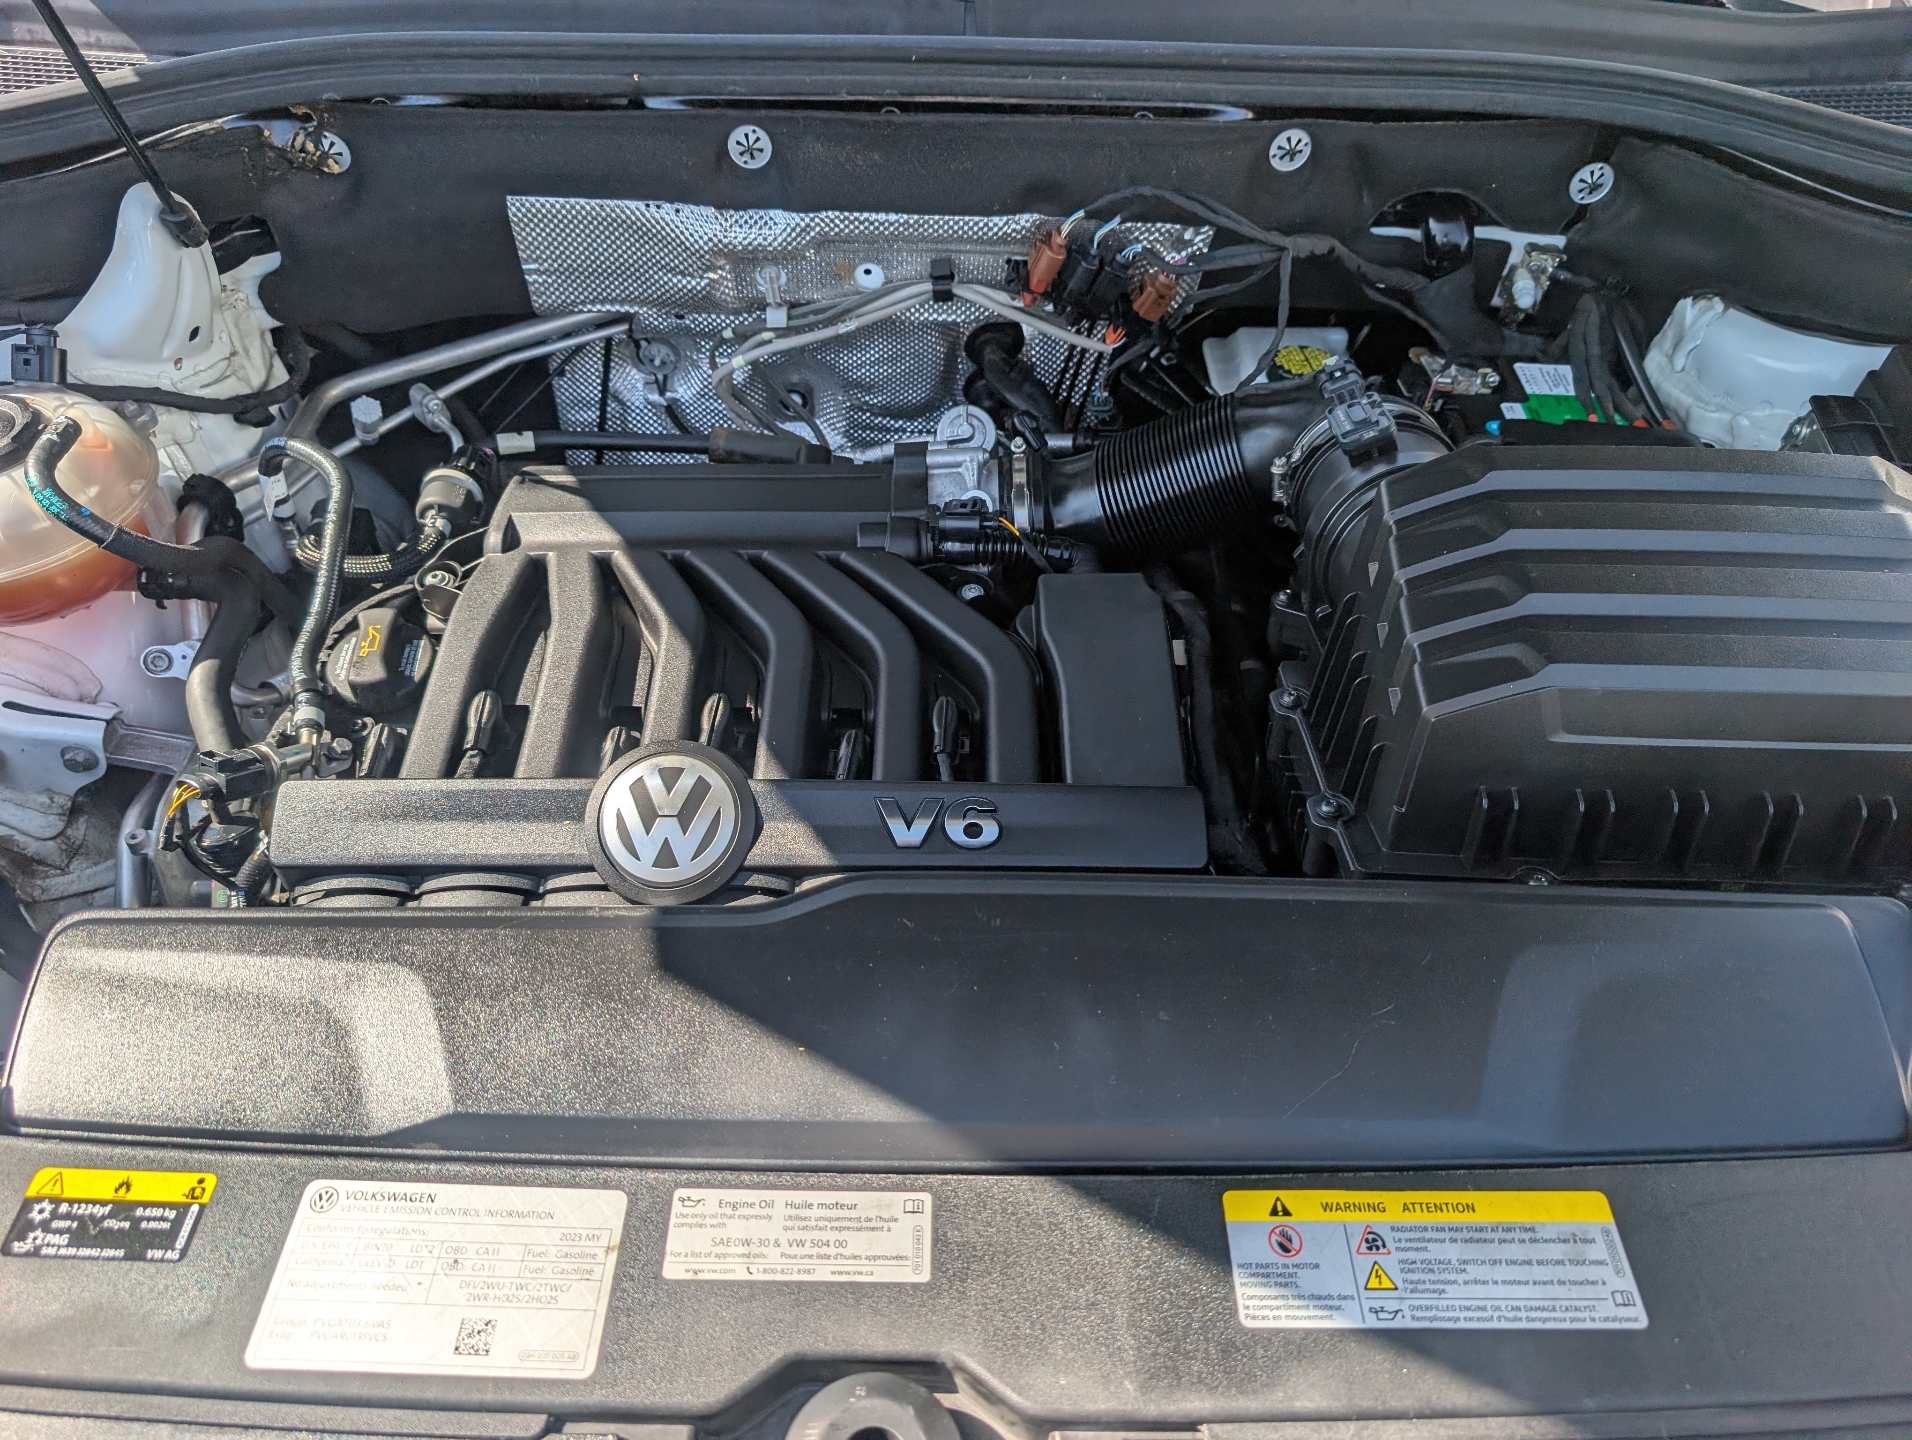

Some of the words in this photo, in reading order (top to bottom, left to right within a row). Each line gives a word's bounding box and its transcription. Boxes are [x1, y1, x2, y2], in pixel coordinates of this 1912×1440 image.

[874, 797, 1001, 850] V6
[346, 1189, 437, 1204] VOLKSWAGEN
[58, 1202, 113, 1217] R-1234yf
[718, 1198, 756, 1211] Engine
[758, 1199, 775, 1209] Oil
[785, 1200, 814, 1210] Huile
[817, 1202, 858, 1210] moteur
[1320, 1201, 1386, 1213] WARNING
[1402, 1202, 1476, 1214] ATTENTION
[135, 1206, 163, 1217] 0.650
[164, 1207, 177, 1219] kg
[341, 1204, 380, 1214] VEHICLE
[383, 1204, 432, 1215] EMISSION
[435, 1207, 481, 1217] CONTROL
[484, 1209, 555, 1220] INFORMATION
[675, 1211, 690, 1219] Use
[690, 1212, 707, 1221] only
[720, 1212, 736, 1220] that
[738, 1213, 773, 1222] expressly
[783, 1214, 812, 1222] Utilisez
[814, 1215, 862, 1223] uniquement
[307, 1222, 355, 1234] Conforms
[358, 1225, 368, 1234] to
[370, 1225, 430, 1237] regulations:
[673, 1221, 708, 1230] complies
[709, 1221, 727, 1229] with
[782, 1223, 796, 1232] qui
[829, 1224, 884, 1233] expressément
[44, 1233, 70, 1246] PAG
[559, 1232, 582, 1242] 2023
[585, 1233, 602, 1242] MY
[1498, 1236, 1515, 1245] peut
[772, 1238, 781, 1248] &
[787, 1239, 806, 1248] VW
[809, 1239, 831, 1248] 504
[833, 1239, 848, 1248] 00
[445, 1246, 470, 1255] OBD:
[526, 1248, 550, 1258] Fuel:
[555, 1250, 598, 1260] Gasoline
[1395, 1245, 1431, 1253] moment.
[146, 1248, 164, 1260] VW
[164, 1249, 180, 1261] AG
[669, 1250, 682, 1258] For
[714, 1251, 751, 1260] approved
[815, 1252, 832, 1260] liste
[522, 1264, 547, 1274] Fuel:
[551, 1266, 595, 1276] Gasoline
[1237, 1262, 1253, 1270] HOT
[1254, 1262, 1279, 1270] PARTS
[1238, 1271, 1301, 1279] COMPARTMENT.
[1240, 1281, 1272, 1289] MOVING
[1273, 1281, 1302, 1289] PARTS.
[1402, 1278, 1426, 1286] Haute
[1462, 1278, 1490, 1286] arrêter
[1492, 1278, 1499, 1286] le
[1501, 1278, 1530, 1286] moteur
[1531, 1278, 1555, 1286] avant
[1557, 1278, 1566, 1286] de
[1568, 1278, 1599, 1286] toucher
[1241, 1293, 1289, 1303] Composants
[1290, 1293, 1306, 1301] très
[1308, 1293, 1335, 1301] chauds
[1336, 1293, 1355, 1301] dans
[1252, 1303, 1310, 1312] compartiment
[1408, 1304, 1457, 1312] OVERFILLED
[1459, 1304, 1488, 1312] ENGINE
[1490, 1304, 1504, 1312] OIL
[1504, 1304, 1522, 1312] CAN
[1523, 1304, 1558, 1312] DAMAGE
[1244, 1313, 1270, 1321] Pièces
[1410, 1314, 1461, 1323] Remplissage
[1463, 1314, 1494, 1322] excessif
[1525, 1314, 1566, 1323] dangereux
[1568, 1314, 1586, 1323] pour
[1588, 1314, 1596, 1322] le
